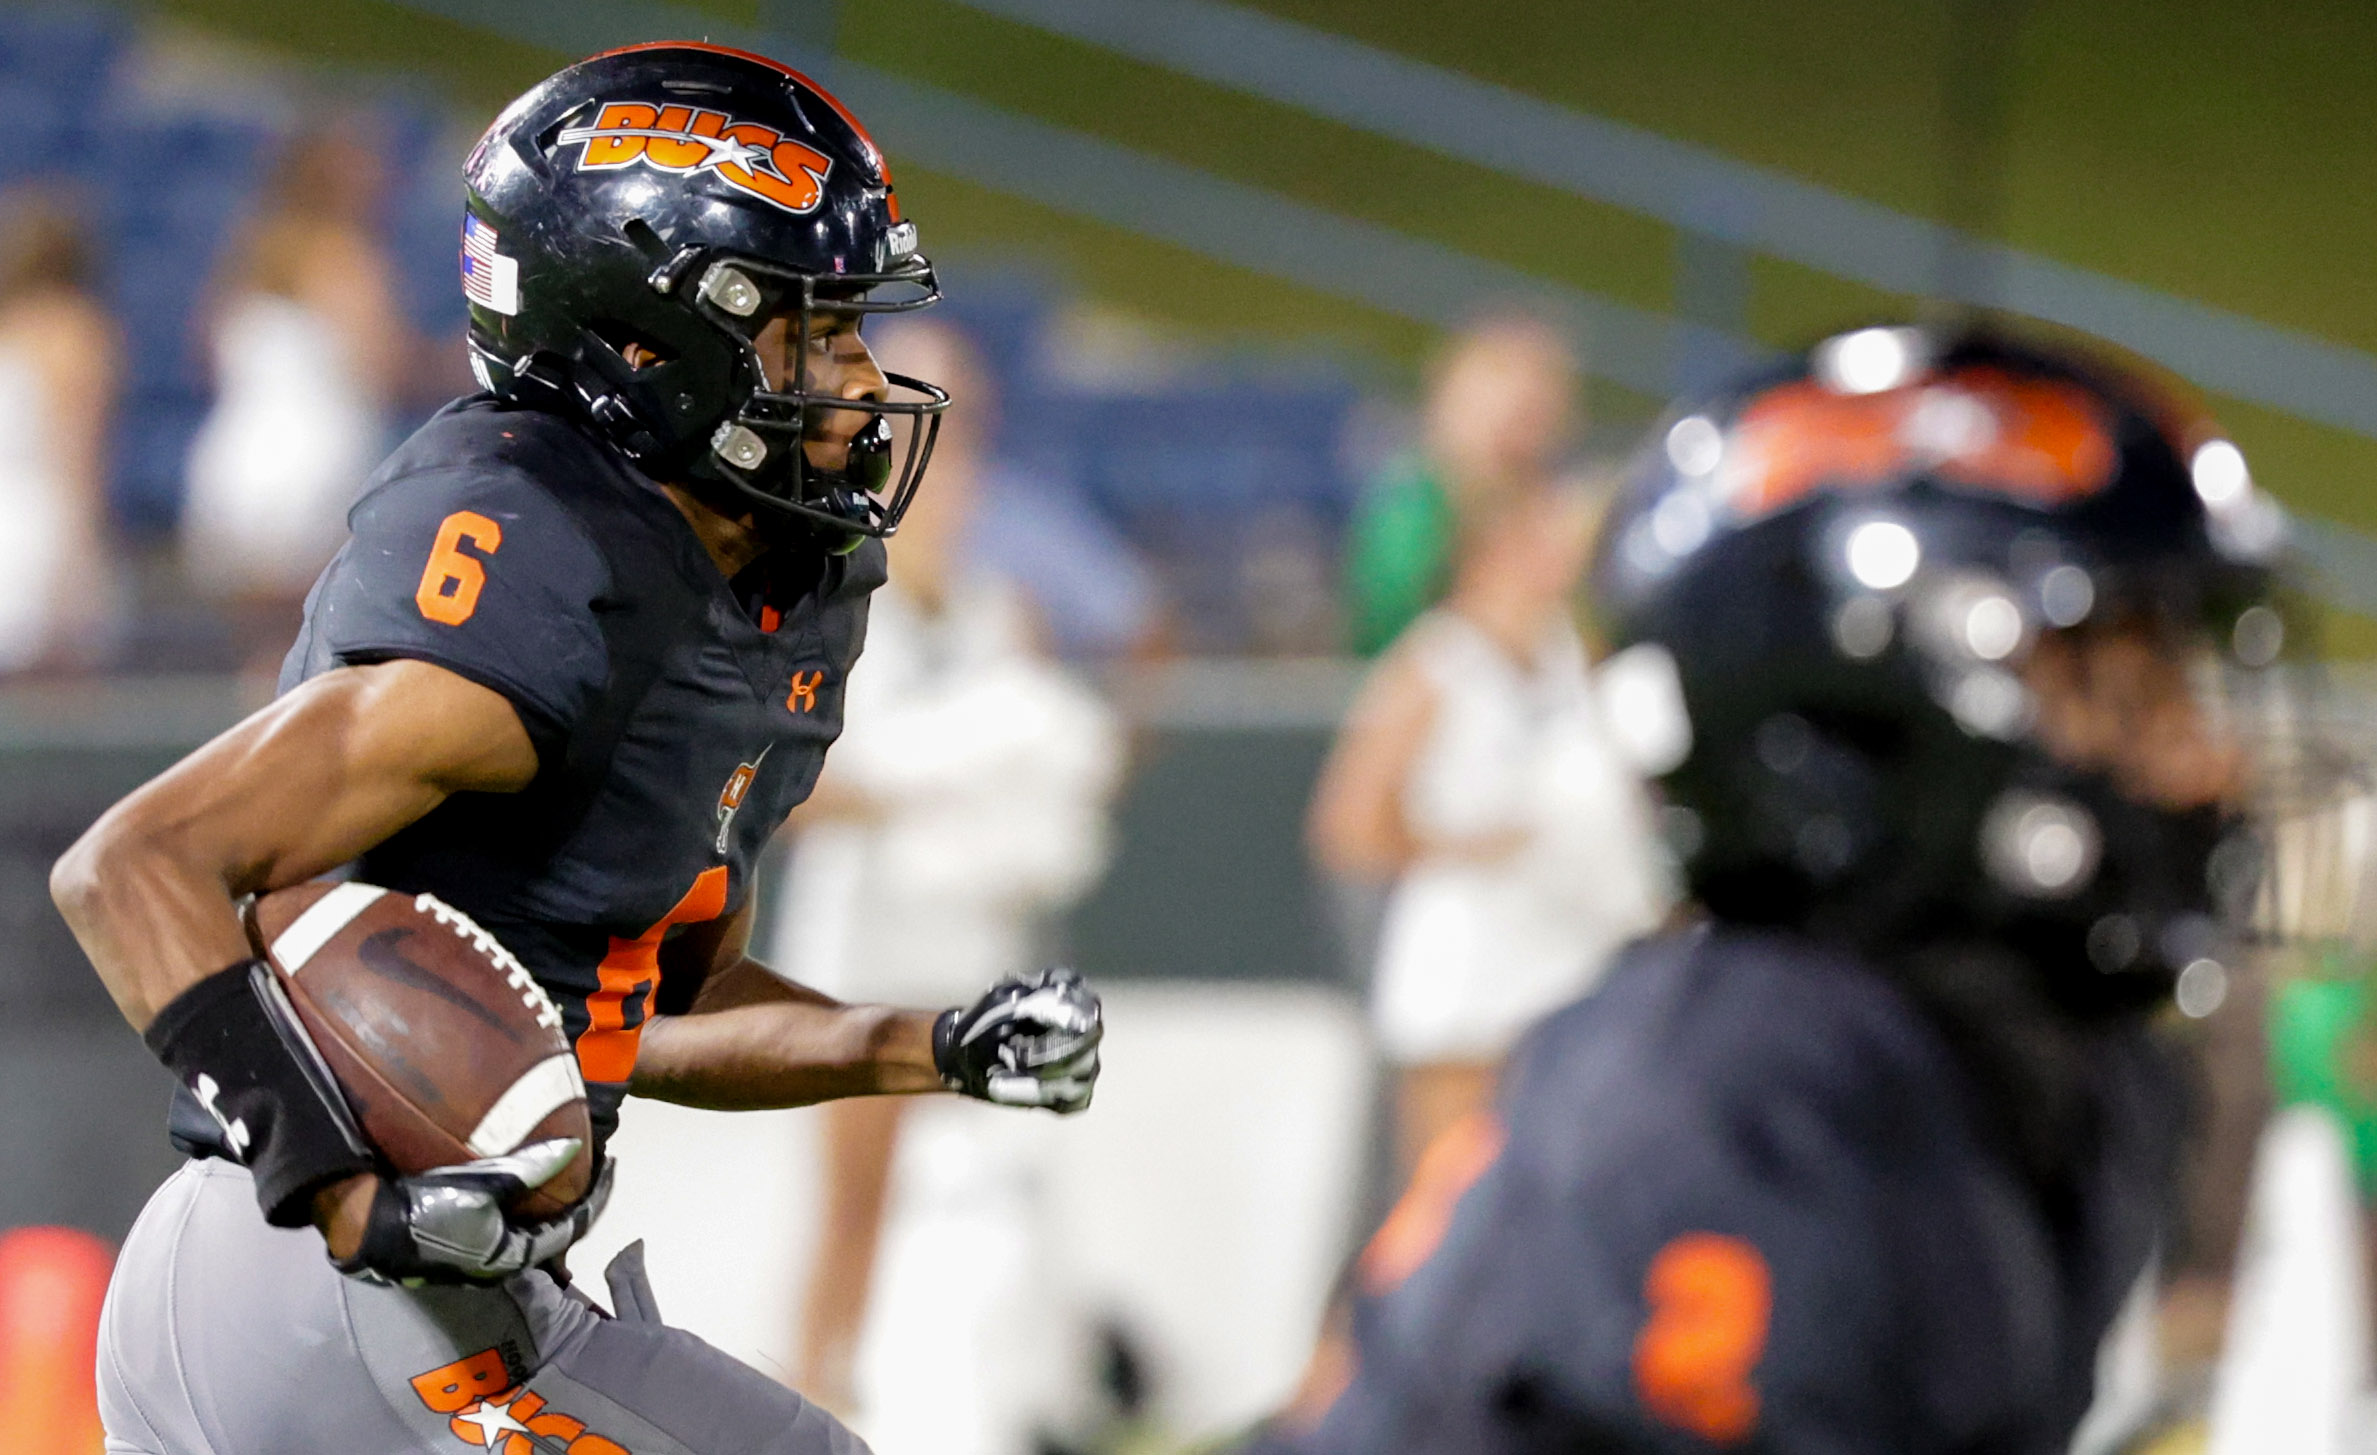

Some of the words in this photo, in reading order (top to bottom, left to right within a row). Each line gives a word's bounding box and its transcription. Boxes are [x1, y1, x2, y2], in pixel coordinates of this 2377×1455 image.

[574, 102, 835, 215] BUCS
[415, 509, 504, 627] 6
[576, 865, 728, 1083] 6
